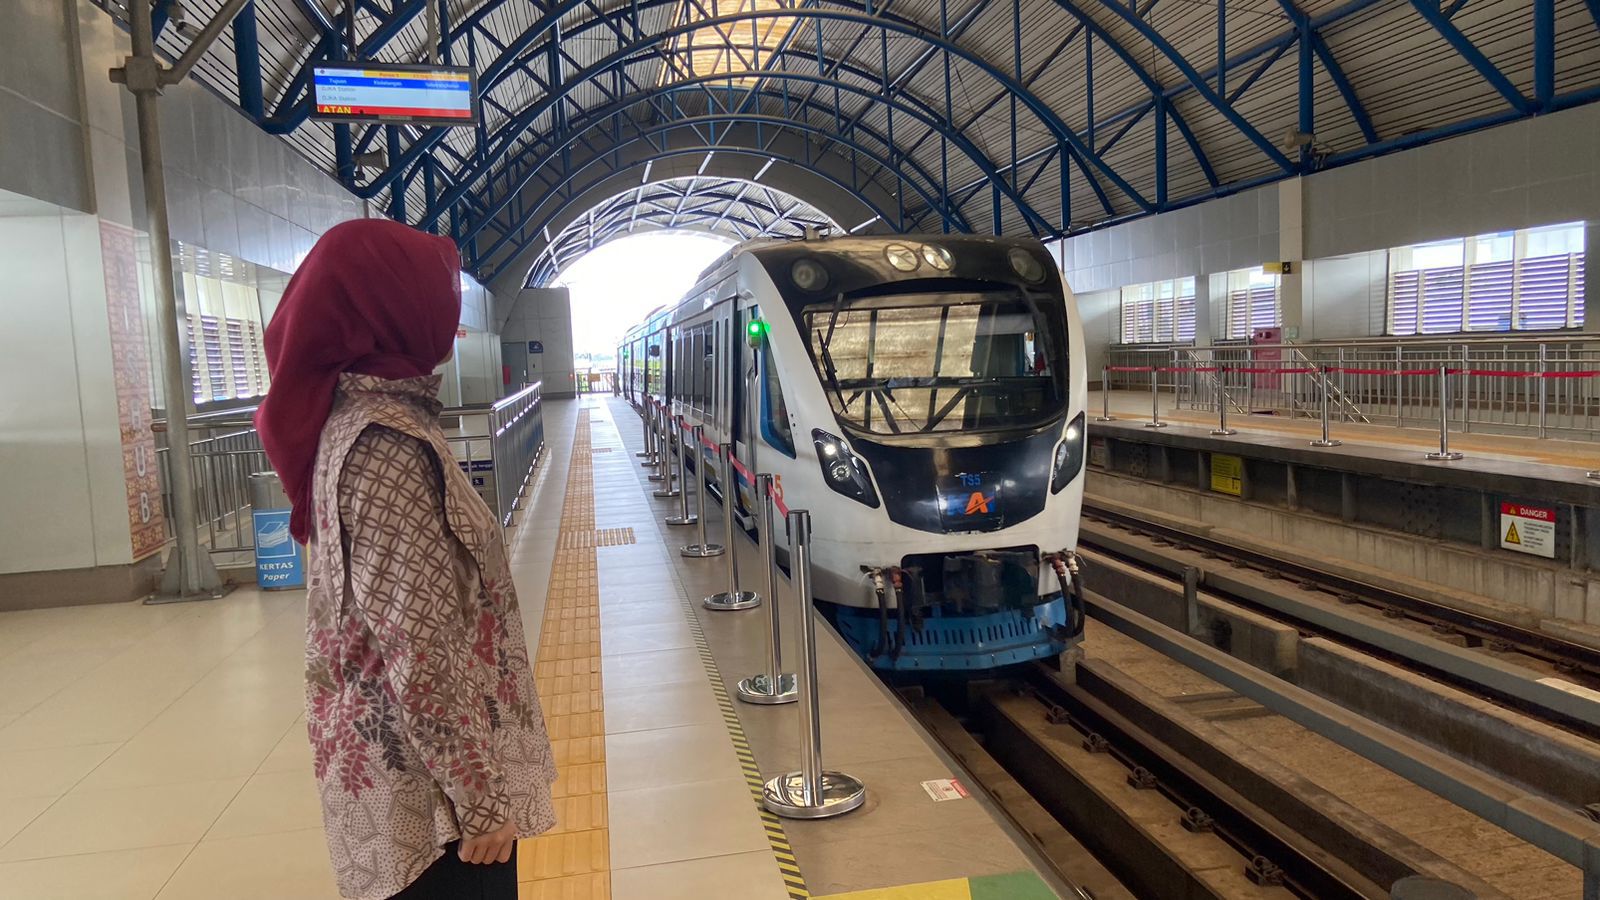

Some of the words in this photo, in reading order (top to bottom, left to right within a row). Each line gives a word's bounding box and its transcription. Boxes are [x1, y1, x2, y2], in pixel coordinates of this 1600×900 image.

[1520, 508, 1548, 519] DANGER
[259, 561, 294, 570] KERTAS
[263, 572, 290, 582] Paper
